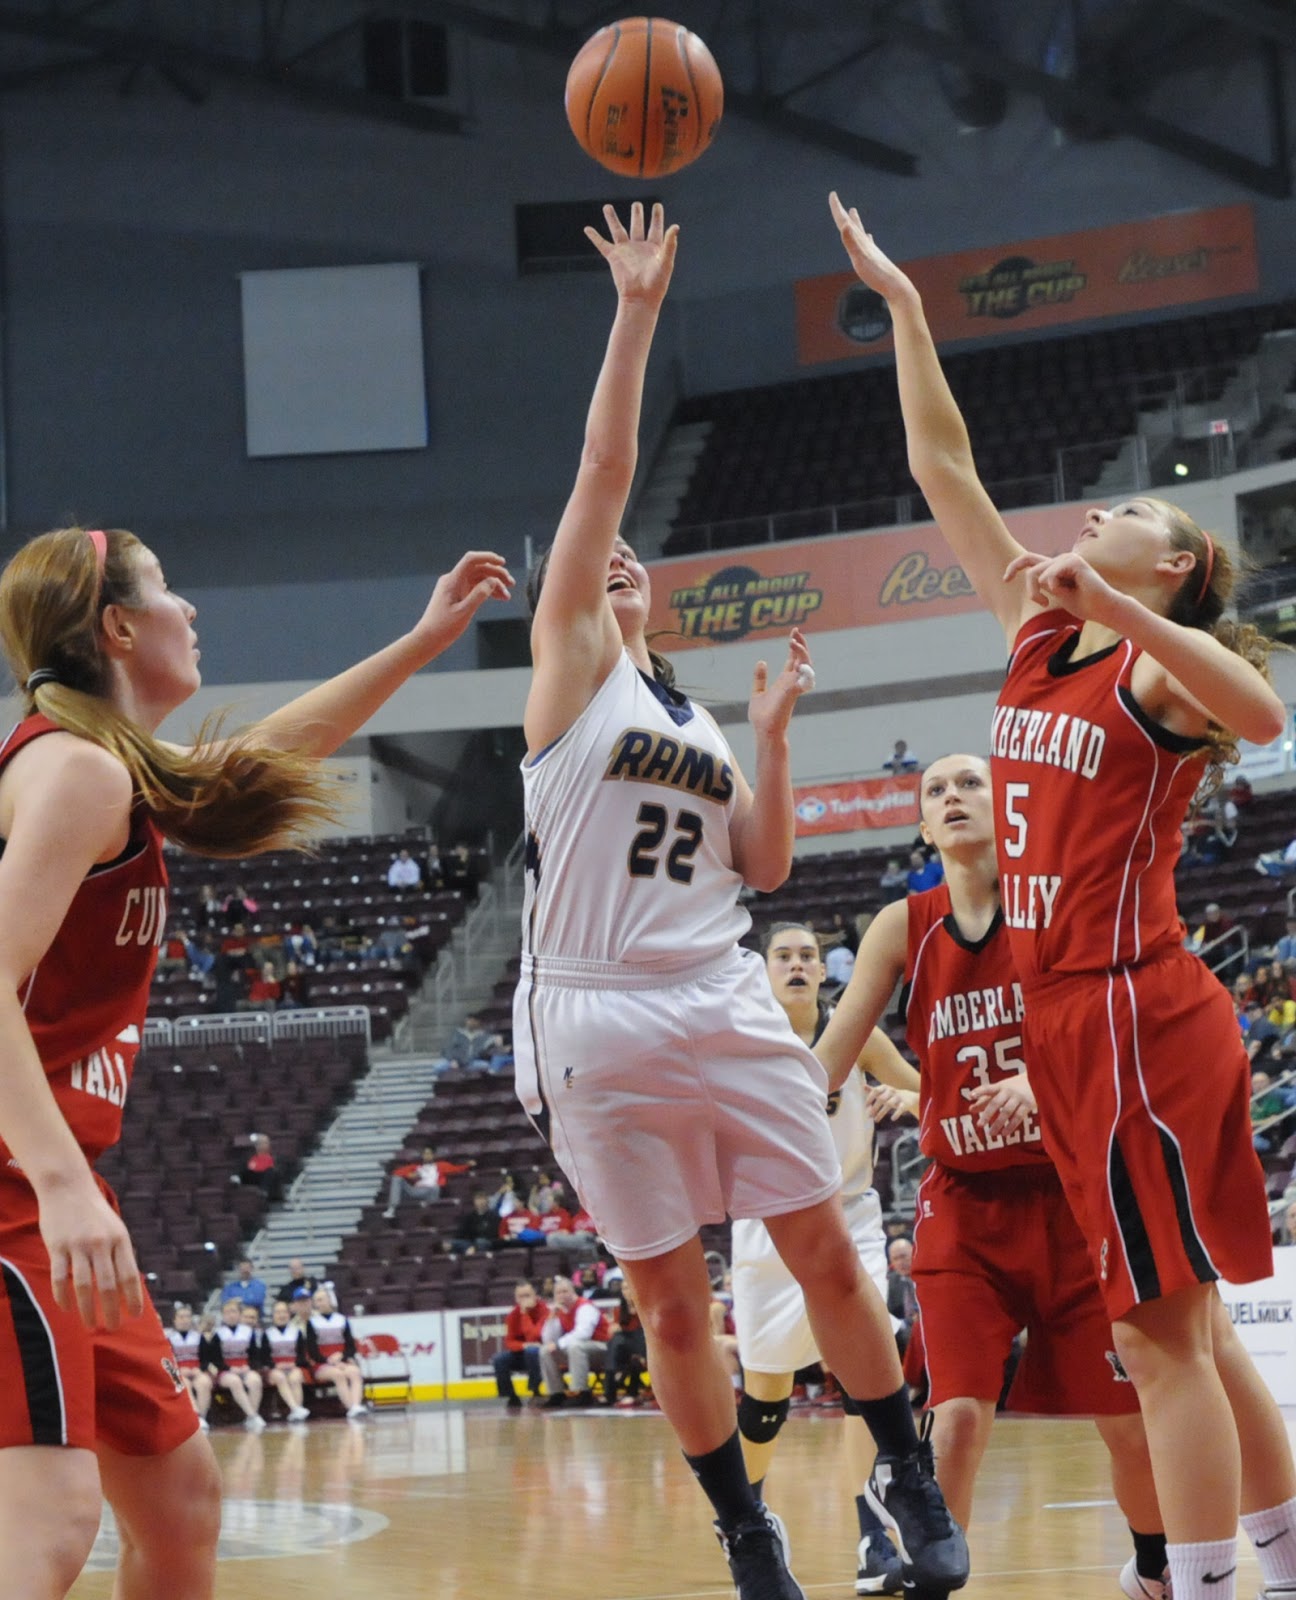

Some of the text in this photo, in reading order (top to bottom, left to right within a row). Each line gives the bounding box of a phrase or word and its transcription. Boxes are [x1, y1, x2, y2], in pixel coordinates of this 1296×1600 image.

[681, 591, 822, 638] THE CUP
[605, 728, 735, 804] RAMS
[627, 801, 703, 886] 22
[1004, 782, 1030, 858] 5
